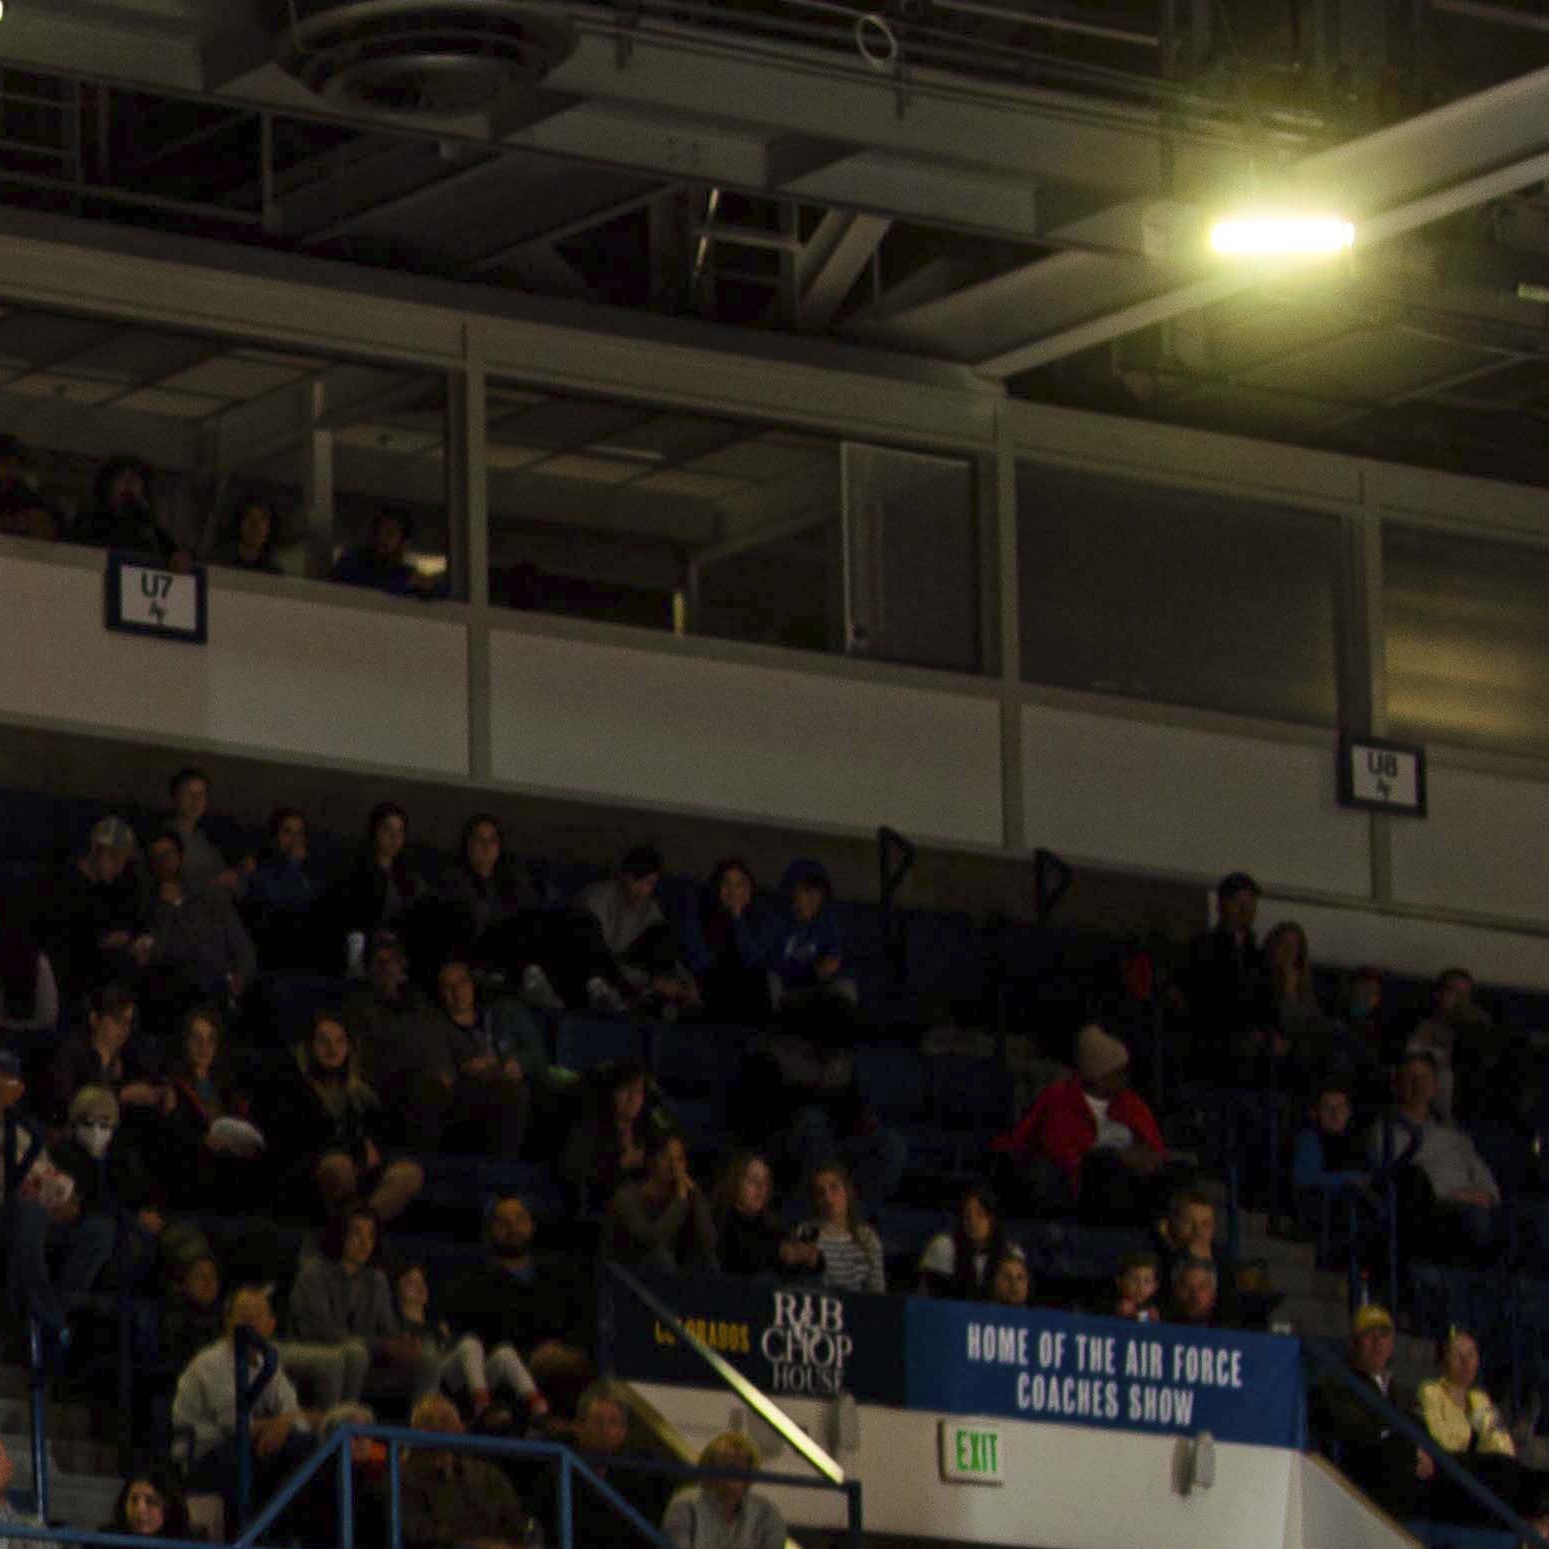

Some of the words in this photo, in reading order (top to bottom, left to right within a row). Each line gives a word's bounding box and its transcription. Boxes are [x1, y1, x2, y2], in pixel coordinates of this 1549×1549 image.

[141, 573, 173, 600] U7
[762, 1325, 853, 1367] CHOP
[966, 1322, 1030, 1367] HOME
[1038, 1331, 1069, 1371] OF
[1076, 1335, 1117, 1375] THE
[1125, 1341, 1164, 1381] AIR
[1174, 1345, 1243, 1388] FORCE
[1017, 1372, 1120, 1419] COACHES
[1129, 1384, 1194, 1426] SHOW
[957, 1430, 998, 1472] EXIT
